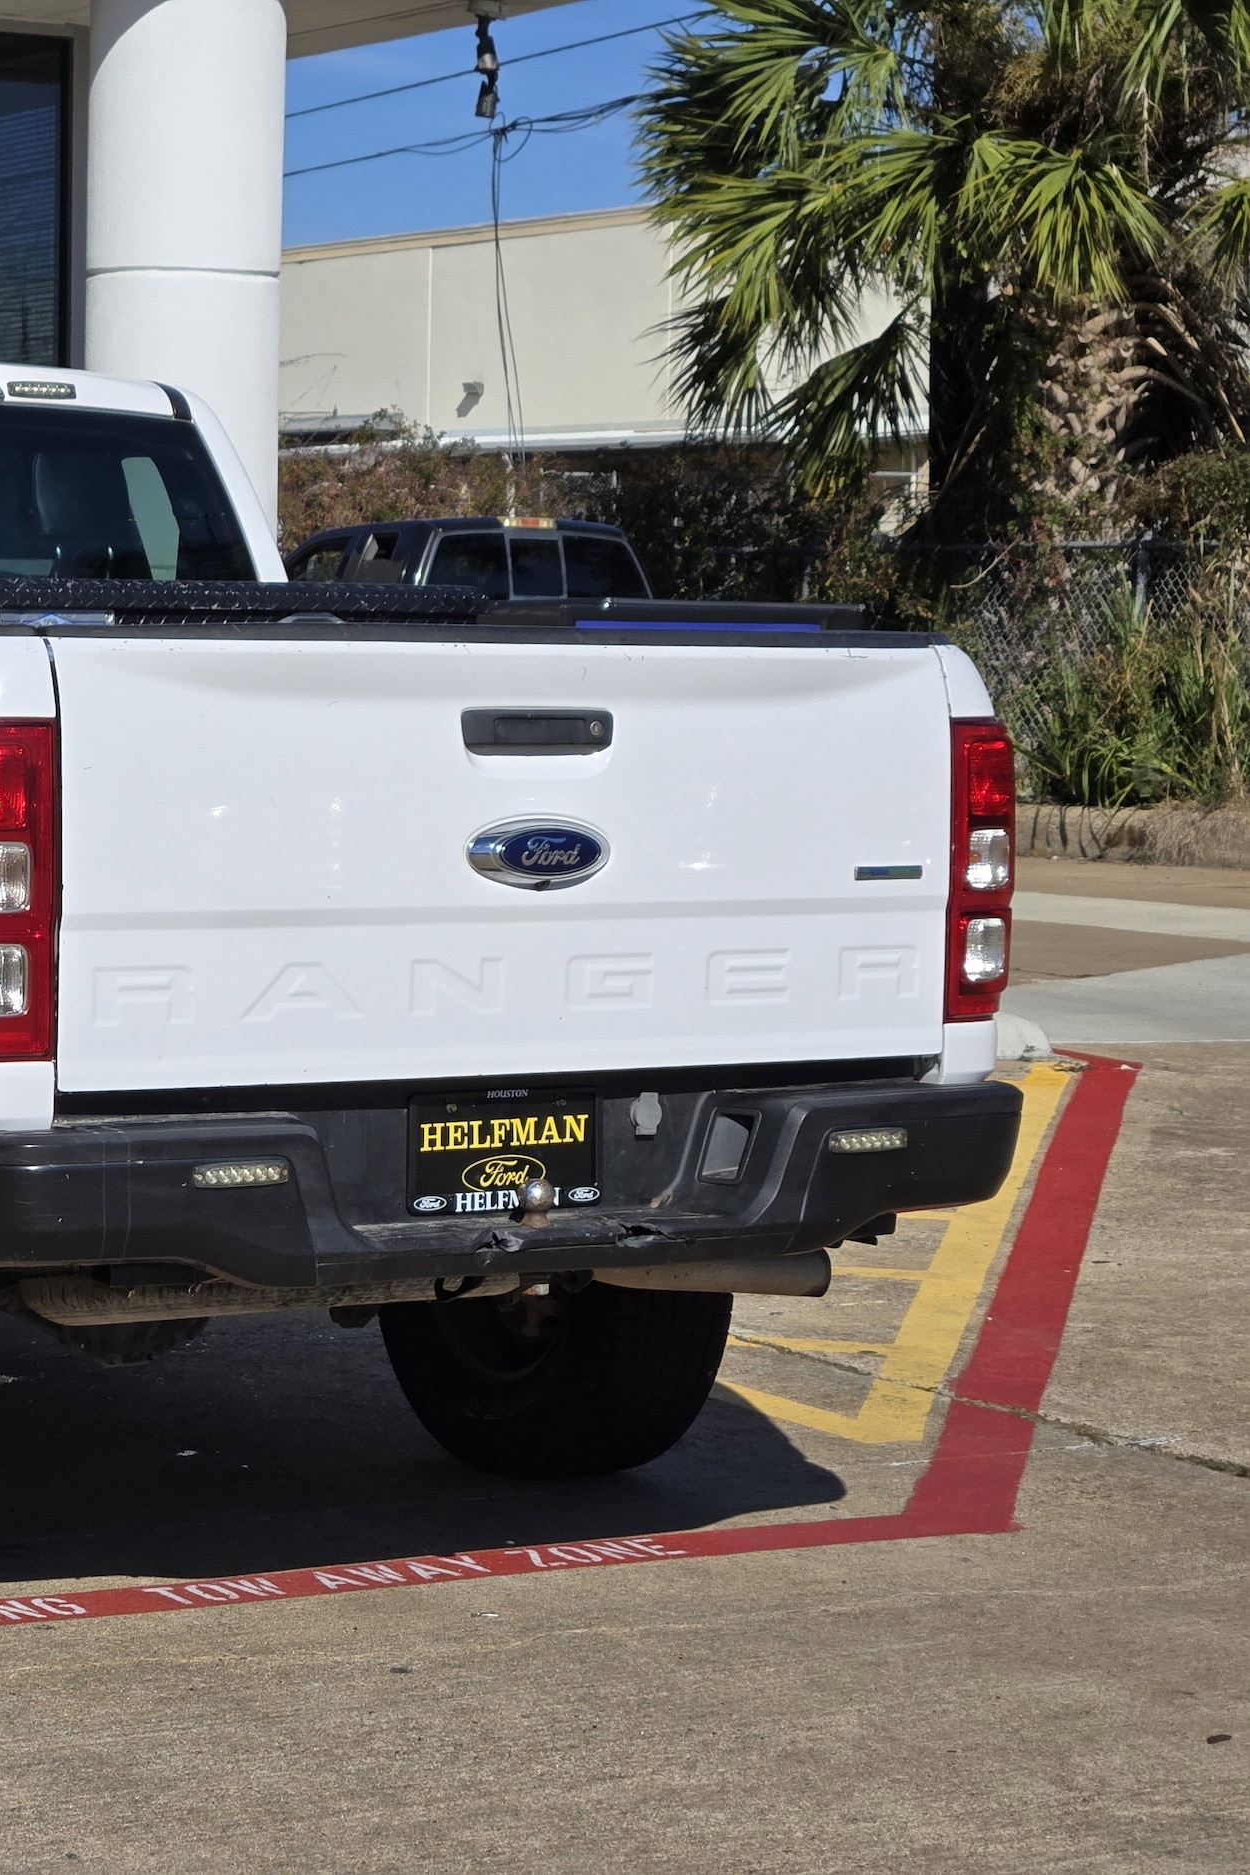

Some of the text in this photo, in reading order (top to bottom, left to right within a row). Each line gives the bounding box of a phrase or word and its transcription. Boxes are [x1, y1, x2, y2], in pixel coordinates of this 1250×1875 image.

[522, 836, 580, 866] Ford
[92, 944, 921, 1028] RANGER
[486, 1089, 529, 1099] HOUSTON
[419, 1114, 589, 1152] HELFMAN
[479, 1160, 530, 1187] Ford
[147, 1577, 286, 1606] TOW
[312, 1553, 492, 1591] AWAY
[504, 1537, 686, 1568] ZONE
